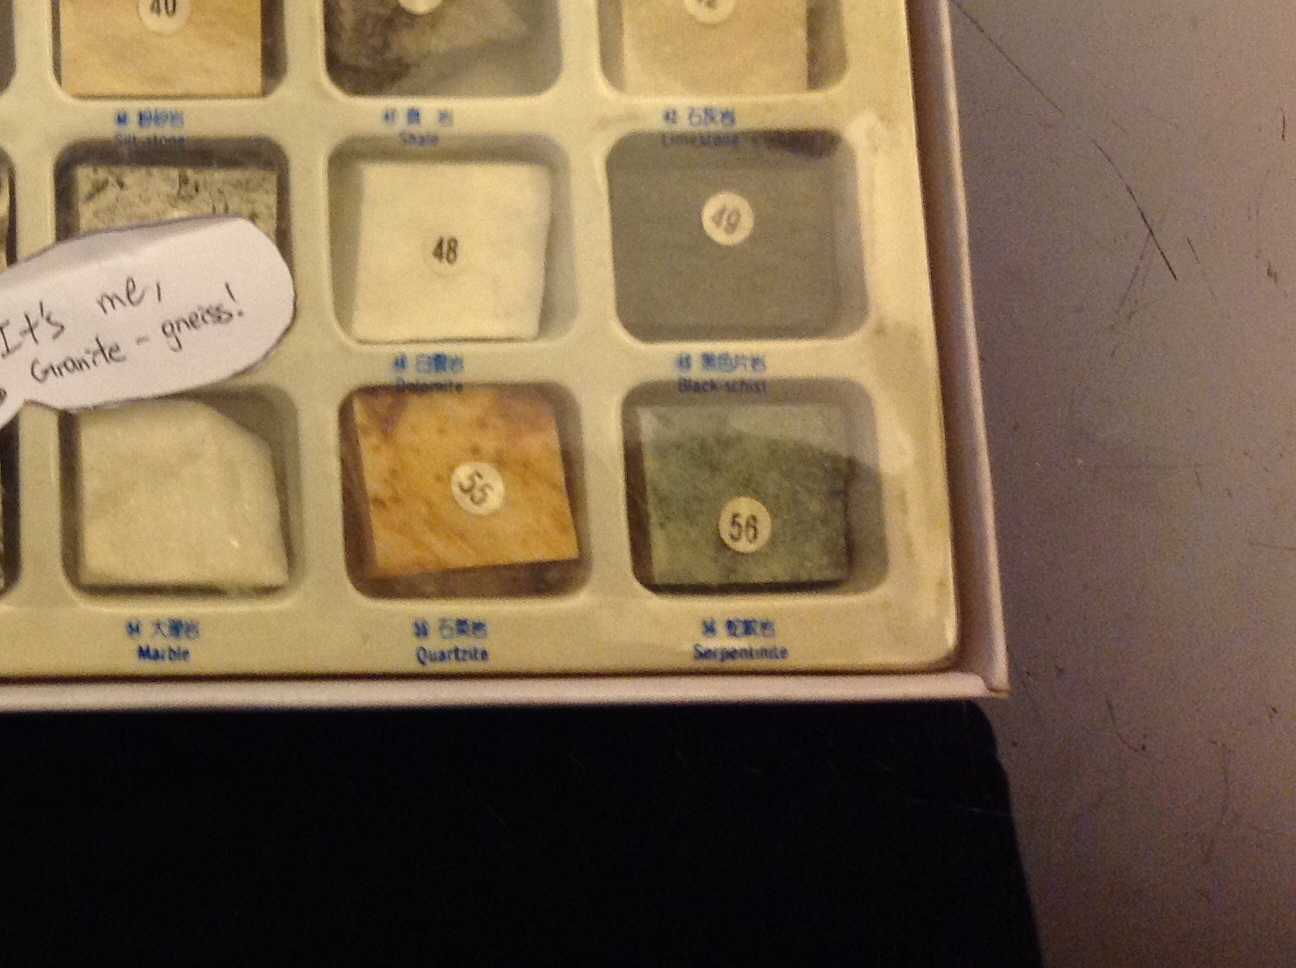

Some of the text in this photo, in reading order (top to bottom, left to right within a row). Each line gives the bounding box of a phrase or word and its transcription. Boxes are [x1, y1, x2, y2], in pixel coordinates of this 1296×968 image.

[711, 203, 741, 235] 49
[432, 235, 459, 265] 48
[95, 276, 163, 316] me,
[30, 334, 128, 384] Granite
[161, 281, 245, 353] gneiss!
[458, 469, 495, 507] 55
[730, 512, 758, 544] 56
[137, 644, 191, 663] Marble
